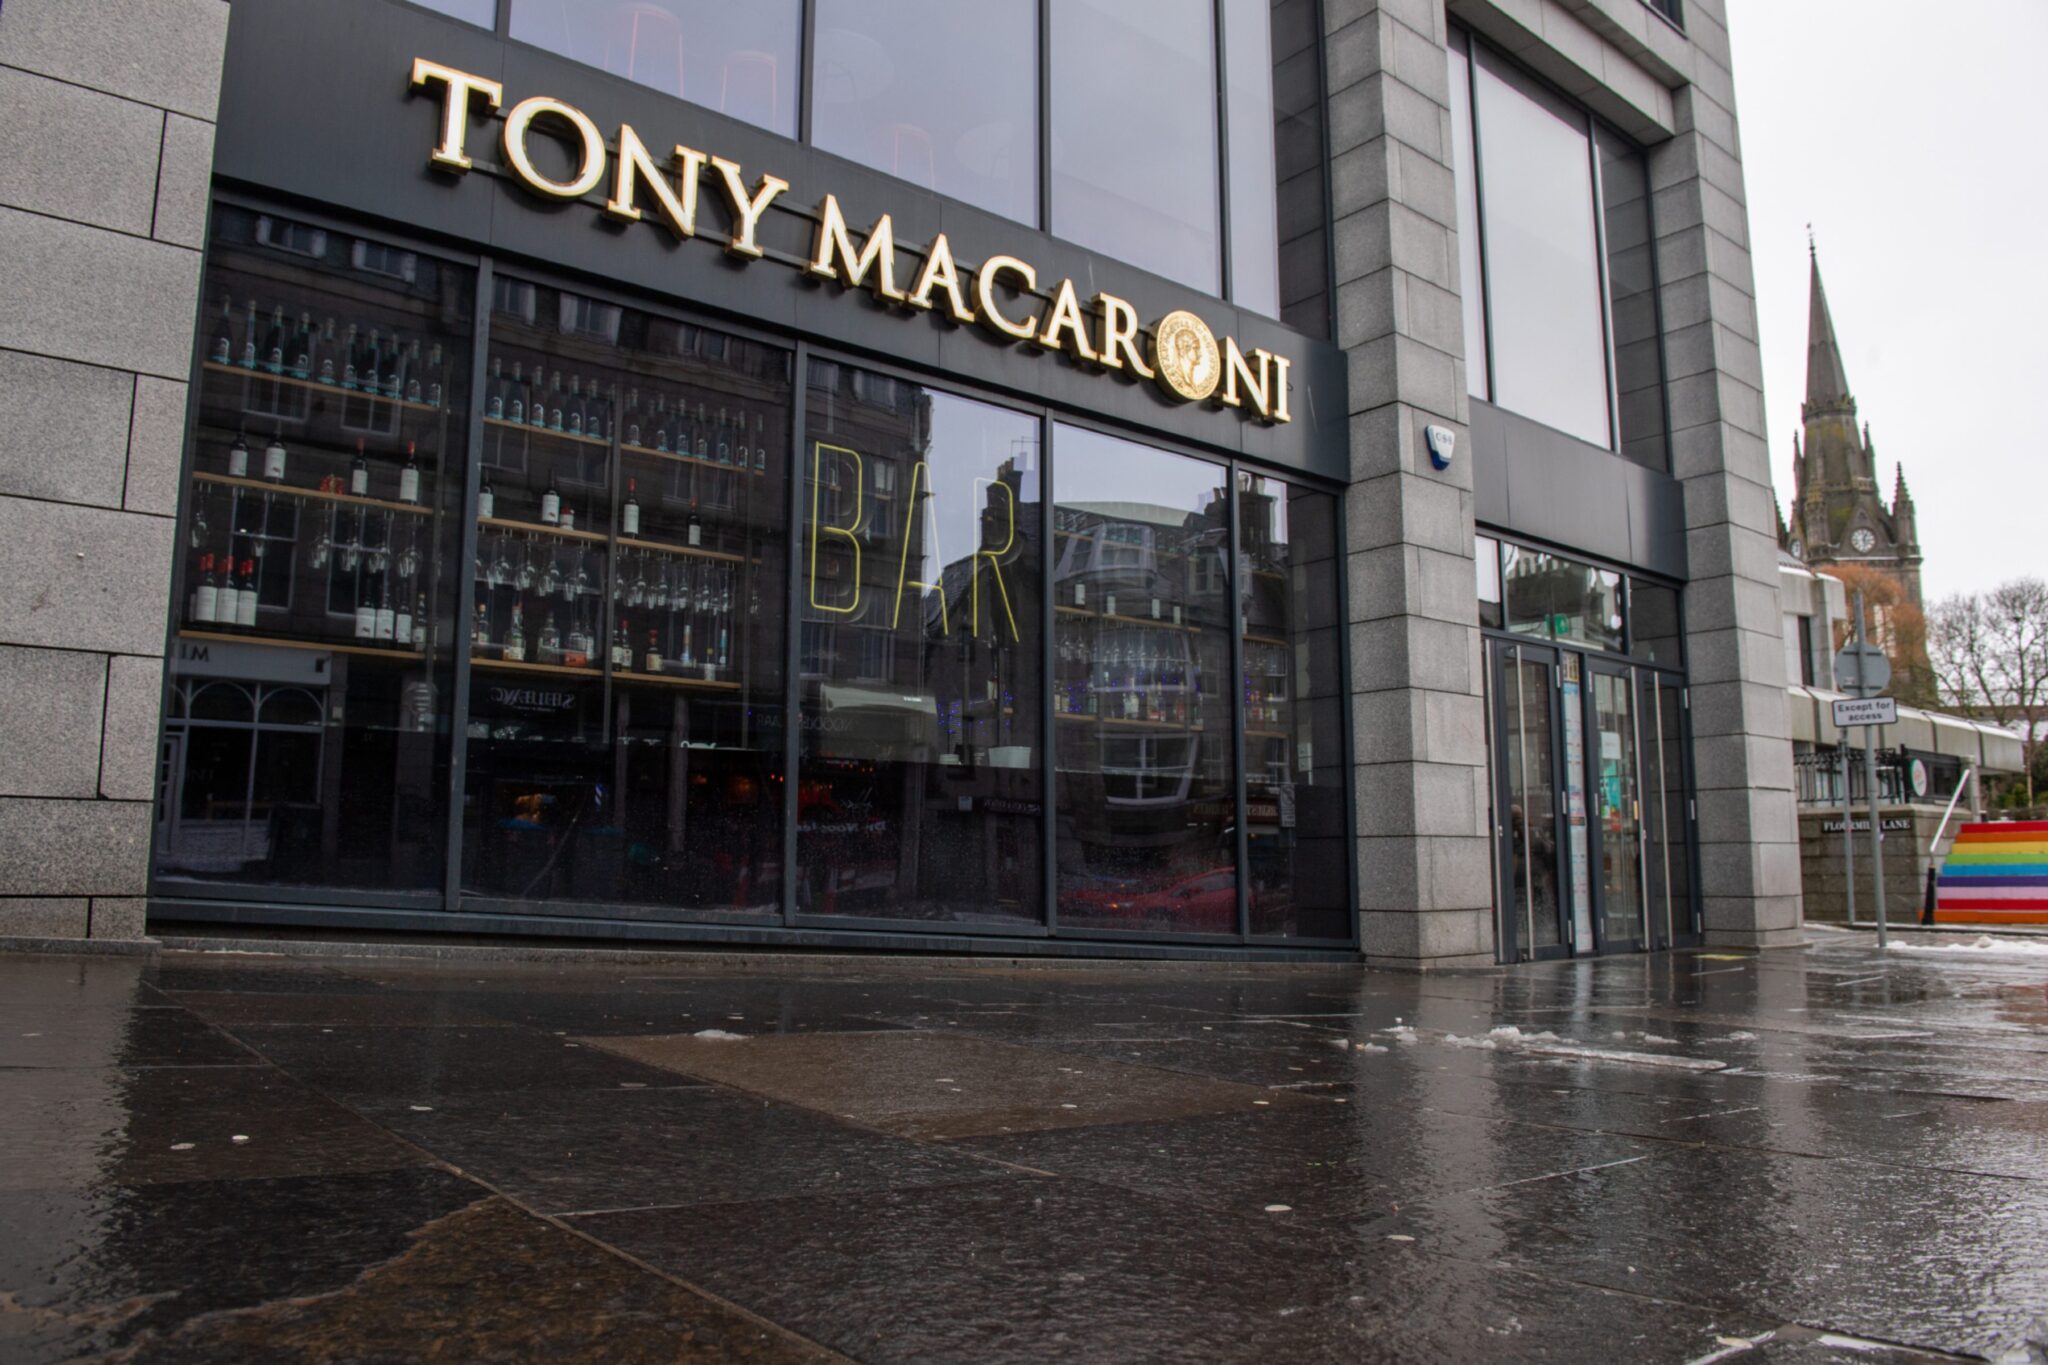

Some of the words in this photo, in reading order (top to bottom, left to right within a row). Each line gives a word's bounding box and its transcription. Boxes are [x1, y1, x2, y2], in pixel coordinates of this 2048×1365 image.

[410, 57, 789, 262] TONY
[804, 193, 1292, 425] MACARONI
[810, 440, 1020, 643] BAR
[1837, 703, 1873, 713] Except
[1876, 701, 1891, 710] for
[1848, 713, 1883, 721] access
[1882, 819, 1911, 830] LANE
